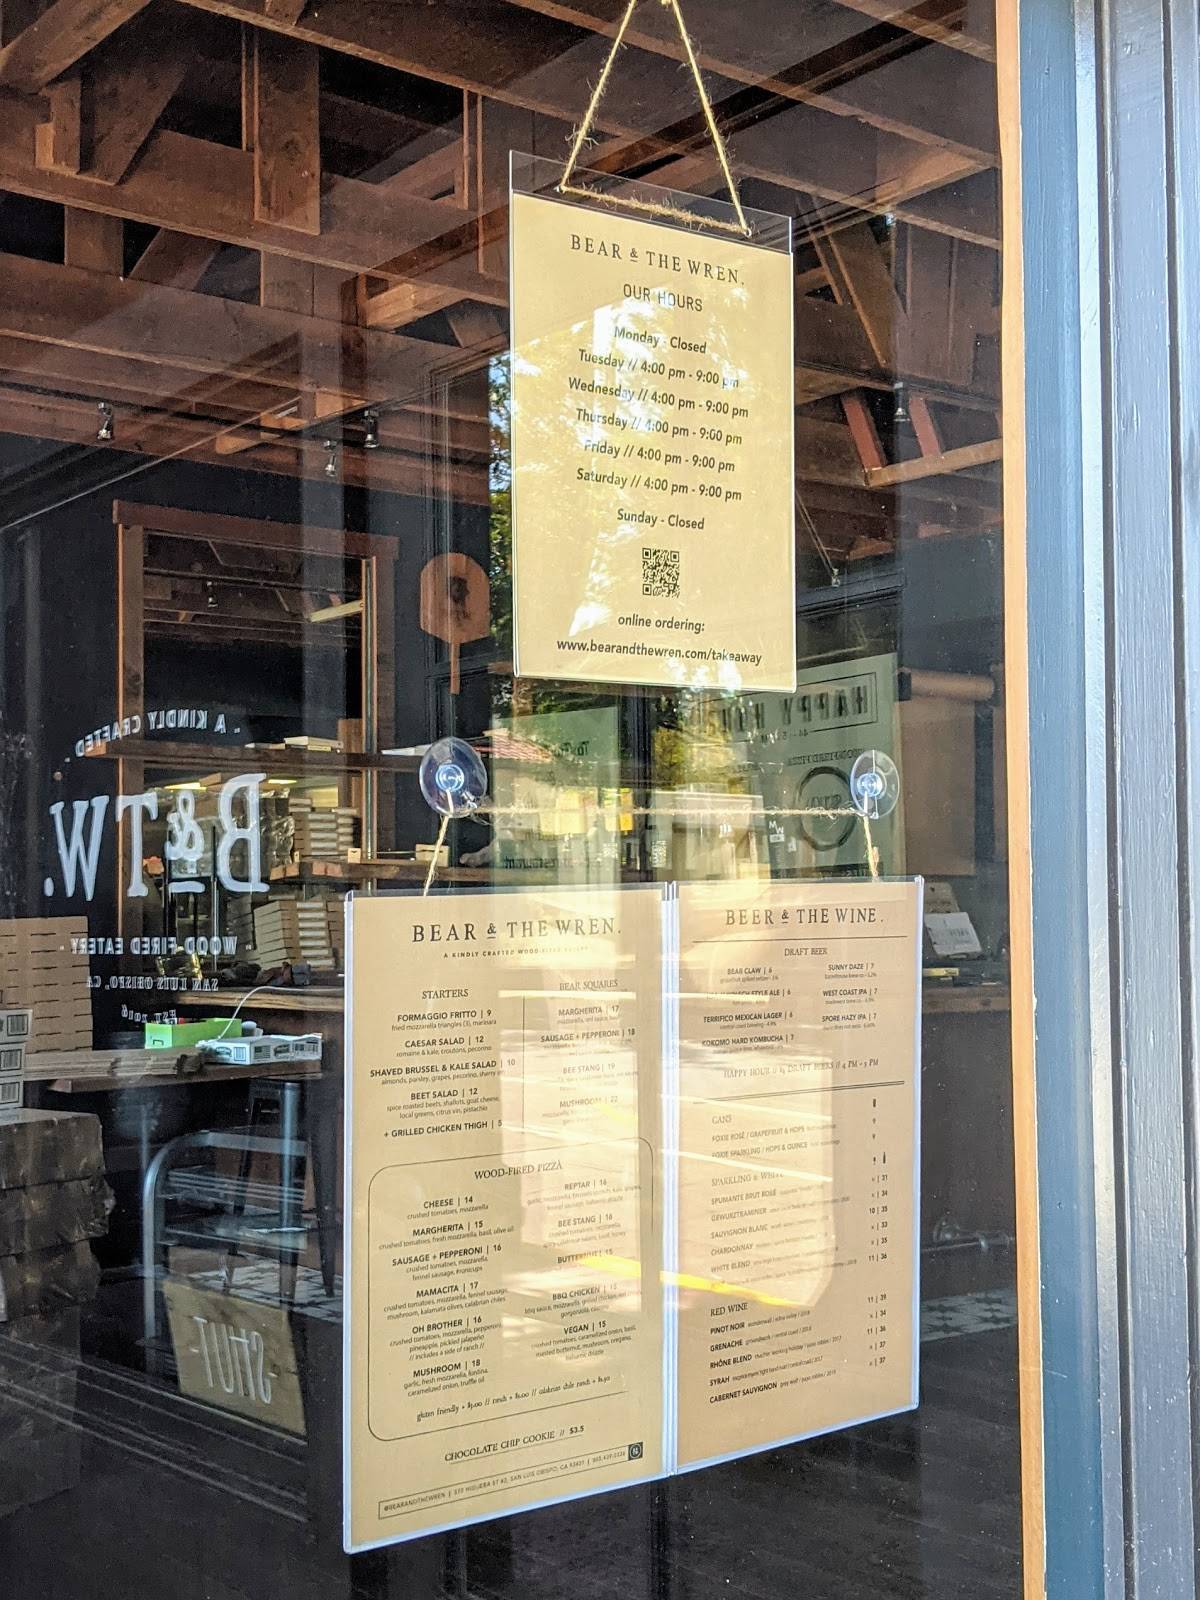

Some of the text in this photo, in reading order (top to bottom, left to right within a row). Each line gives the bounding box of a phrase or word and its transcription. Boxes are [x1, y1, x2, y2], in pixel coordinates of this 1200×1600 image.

[571, 234, 622, 259] BEAR
[630, 248, 638, 262] &
[646, 251, 681, 272] THE
[623, 284, 702, 312] OUR HOURS
[614, 326, 706, 354] Monday Closed
[579, 349, 739, 390] Tuesday 4:00 pm 9:00 pm
[569, 377, 748, 419] Wednesday 4:00 pm 9:00 pm
[576, 408, 628, 430] Thursday
[672, 426, 689, 438] pm
[699, 427, 722, 441] 9:00
[726, 434, 742, 446] pm
[584, 439, 735, 473] Friday 4:00 pm 9:00 pm
[577, 468, 742, 502] Saturday 4:00 pm 9:00 pm
[617, 508, 705, 530] Sunday Closed
[618, 614, 705, 635] online ordering:
[557, 639, 762, 666] www.bearandthewren.com/takeaway
[726, 909, 774, 925] BEER
[781, 909, 789, 924] &
[797, 908, 829, 924] THE
[412, 923, 476, 942] BEAR
[487, 923, 496, 939] &
[507, 920, 548, 938] THE
[784, 948, 809, 957] DRAFT
[421, 989, 469, 1000] STARTERS
[397, 1010, 477, 1022] FORMAGGIO FRITTO
[558, 1006, 602, 1016] MARGHERITA
[704, 1015, 734, 1023] TERRIFICO
[735, 1013, 762, 1021] MEXICAN
[405, 1039, 437, 1048] CAESAR
[439, 1037, 464, 1046] SALAD
[541, 1030, 619, 1043] SAUSAGE PEPPERONI
[702, 1039, 729, 1047] KOKOMO
[749, 1035, 783, 1043] KOMBUCHA
[370, 1068, 403, 1078] SHAVED
[405, 1065, 439, 1075] BRUSSEL
[450, 1062, 469, 1071] KALE
[471, 1061, 497, 1069] SALAD
[410, 1092, 430, 1101] BEET
[432, 1090, 458, 1099] SALAD
[391, 1121, 488, 1137] GRILLED CHICKEN THIGH
[423, 1196, 473, 1209] CHEESE 14
[412, 1220, 484, 1237] MARGHERITA 15
[392, 1254, 430, 1266] SAUSAGE
[439, 1246, 483, 1259] PEPPERONI
[416, 1281, 479, 1298] MAMACITA 17
[710, 1302, 748, 1317] RED WINE
[412, 1316, 482, 1334] OH BROTHER 16
[563, 1320, 606, 1335] VEGAN 15
[710, 1322, 745, 1334] PINOT NOIR
[710, 1339, 743, 1352] GRENACHE
[732, 1354, 752, 1364] BLEND
[413, 1359, 481, 1378] MUSHROOM 18
[710, 1376, 730, 1386] SYRAH
[709, 1382, 778, 1403] CABERNET SAUVIGNON
[445, 1442, 498, 1461] CHOCOLATE
[500, 1438, 521, 1449] CHIP
[522, 1431, 555, 1444] COOKIE
